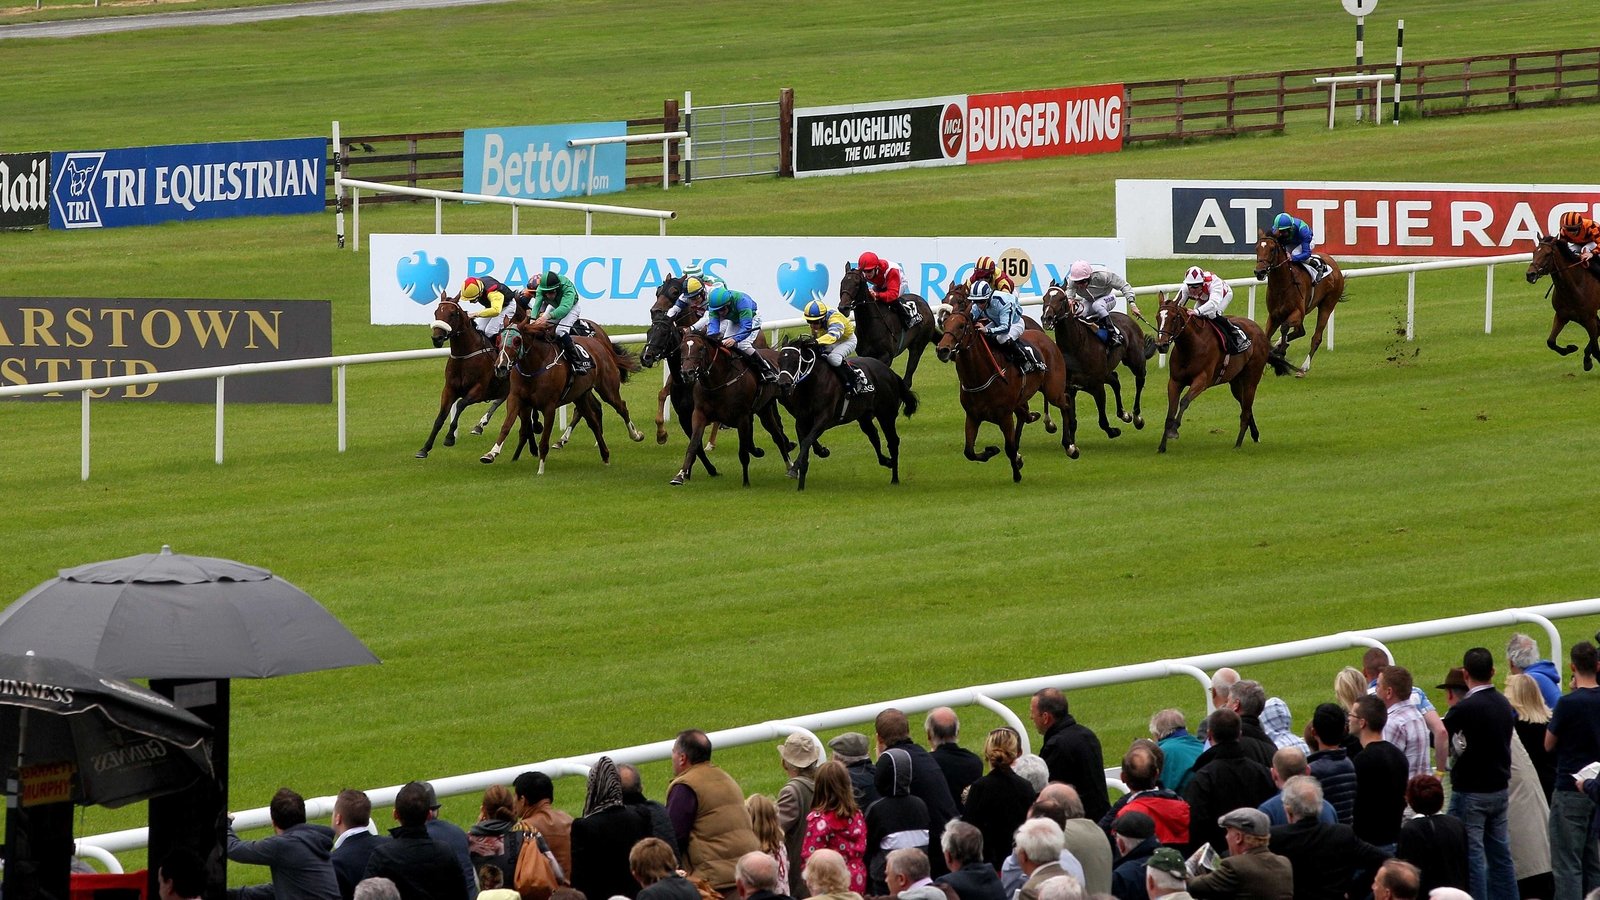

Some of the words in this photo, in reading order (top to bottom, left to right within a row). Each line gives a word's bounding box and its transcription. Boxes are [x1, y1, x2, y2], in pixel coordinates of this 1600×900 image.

[811, 114, 912, 147] McLOUGHLINS
[944, 119, 963, 134] MCL
[969, 102, 1060, 152] BURGER
[1065, 95, 1121, 144] KING
[481, 133, 609, 196] Bettor.om
[844, 147, 861, 162] THE
[864, 144, 877, 160] OIL
[879, 141, 911, 158] PEOPLE
[0, 158, 47, 213] ail
[102, 168, 147, 208] TRI
[155, 158, 319, 211] EQUESTRIAN
[67, 201, 91, 221] TRI
[1185, 197, 1273, 245] AT
[1296, 198, 1434, 247] THE
[1451, 200, 1600, 248] RAC
[1001, 257, 1029, 277] 150
[0, 357, 160, 398] STUD
[0, 678, 74, 704] INNESS
